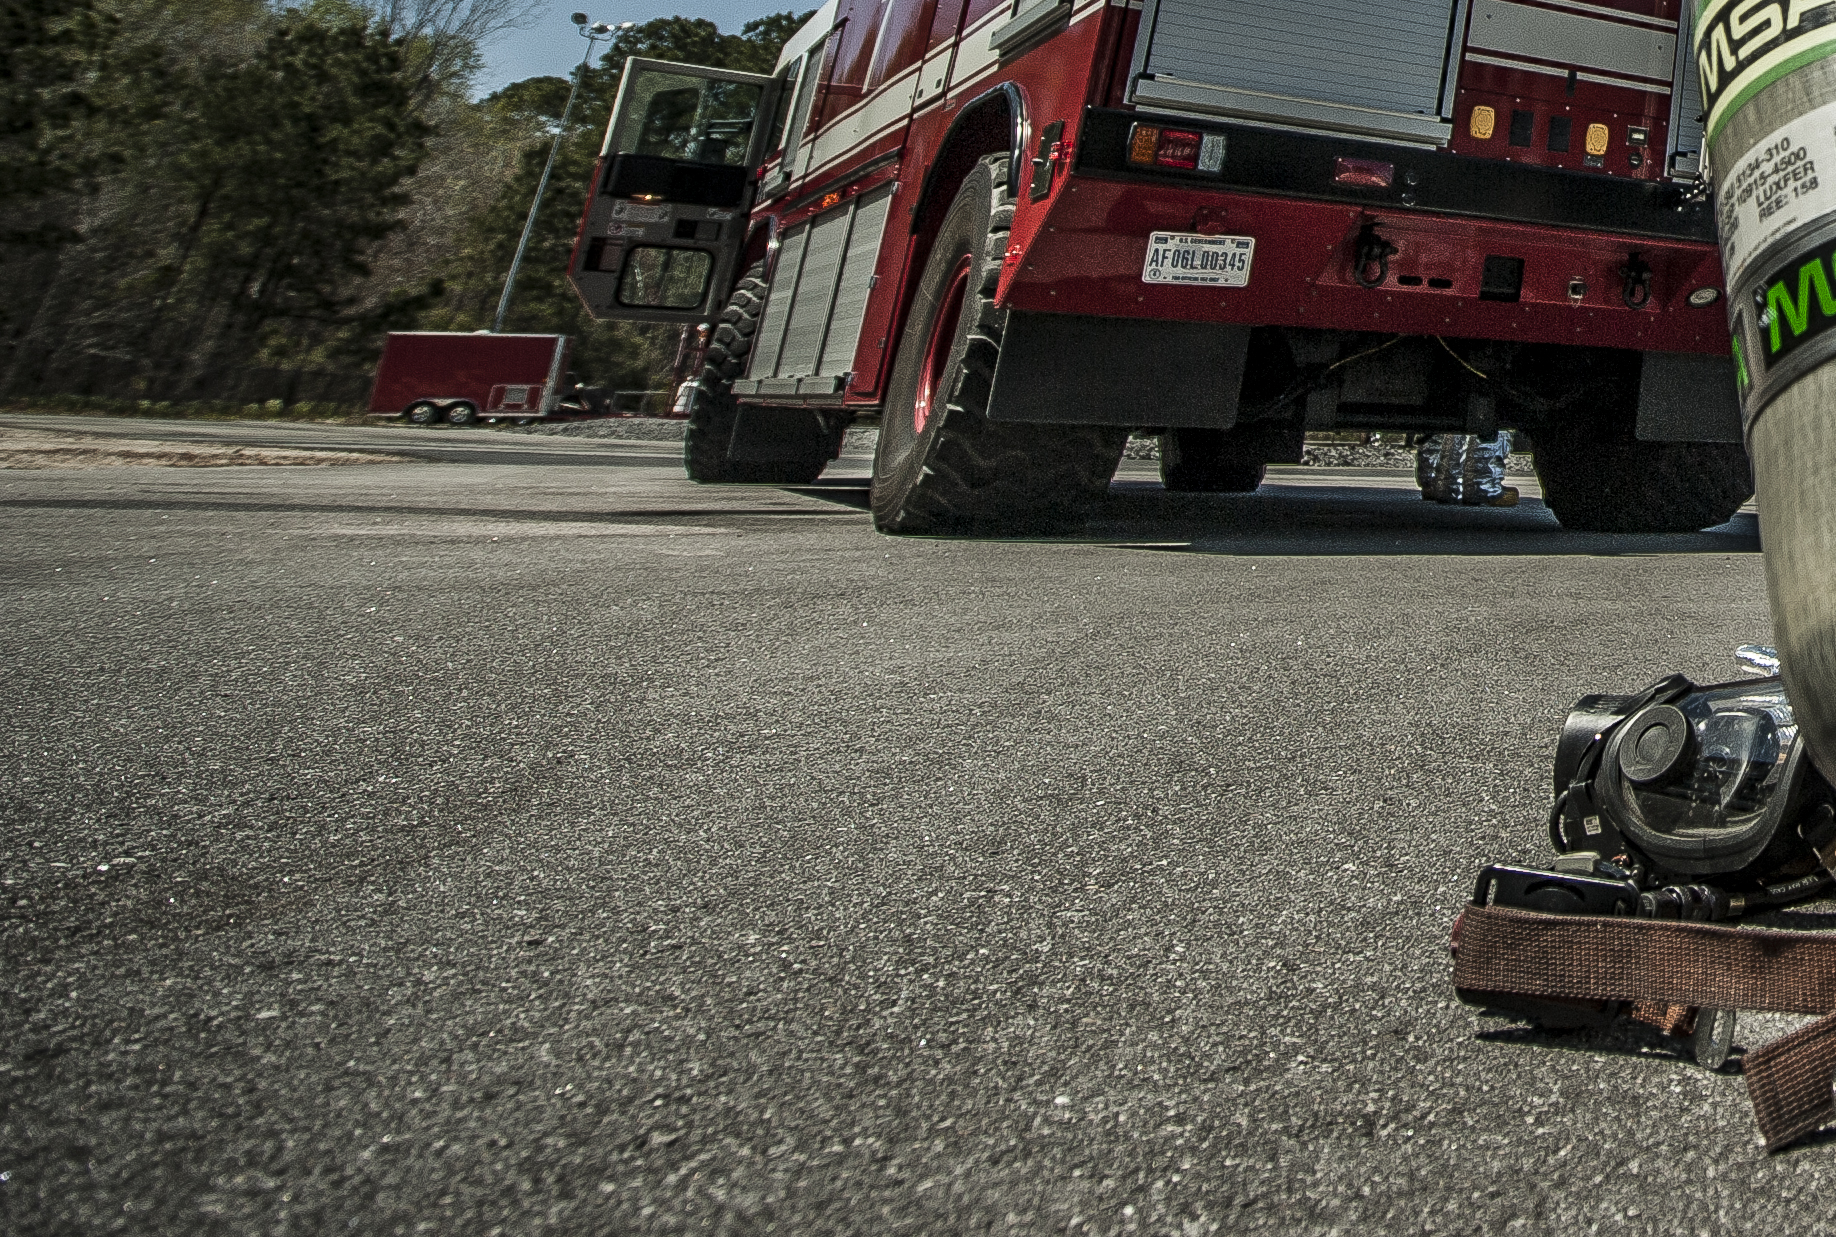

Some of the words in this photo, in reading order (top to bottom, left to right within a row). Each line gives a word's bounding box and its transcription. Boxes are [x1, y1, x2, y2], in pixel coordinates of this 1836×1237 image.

[1755, 160, 1816, 208] LUXFER
[1758, 193, 1789, 223] REE:
[1792, 176, 1819, 199] 158
